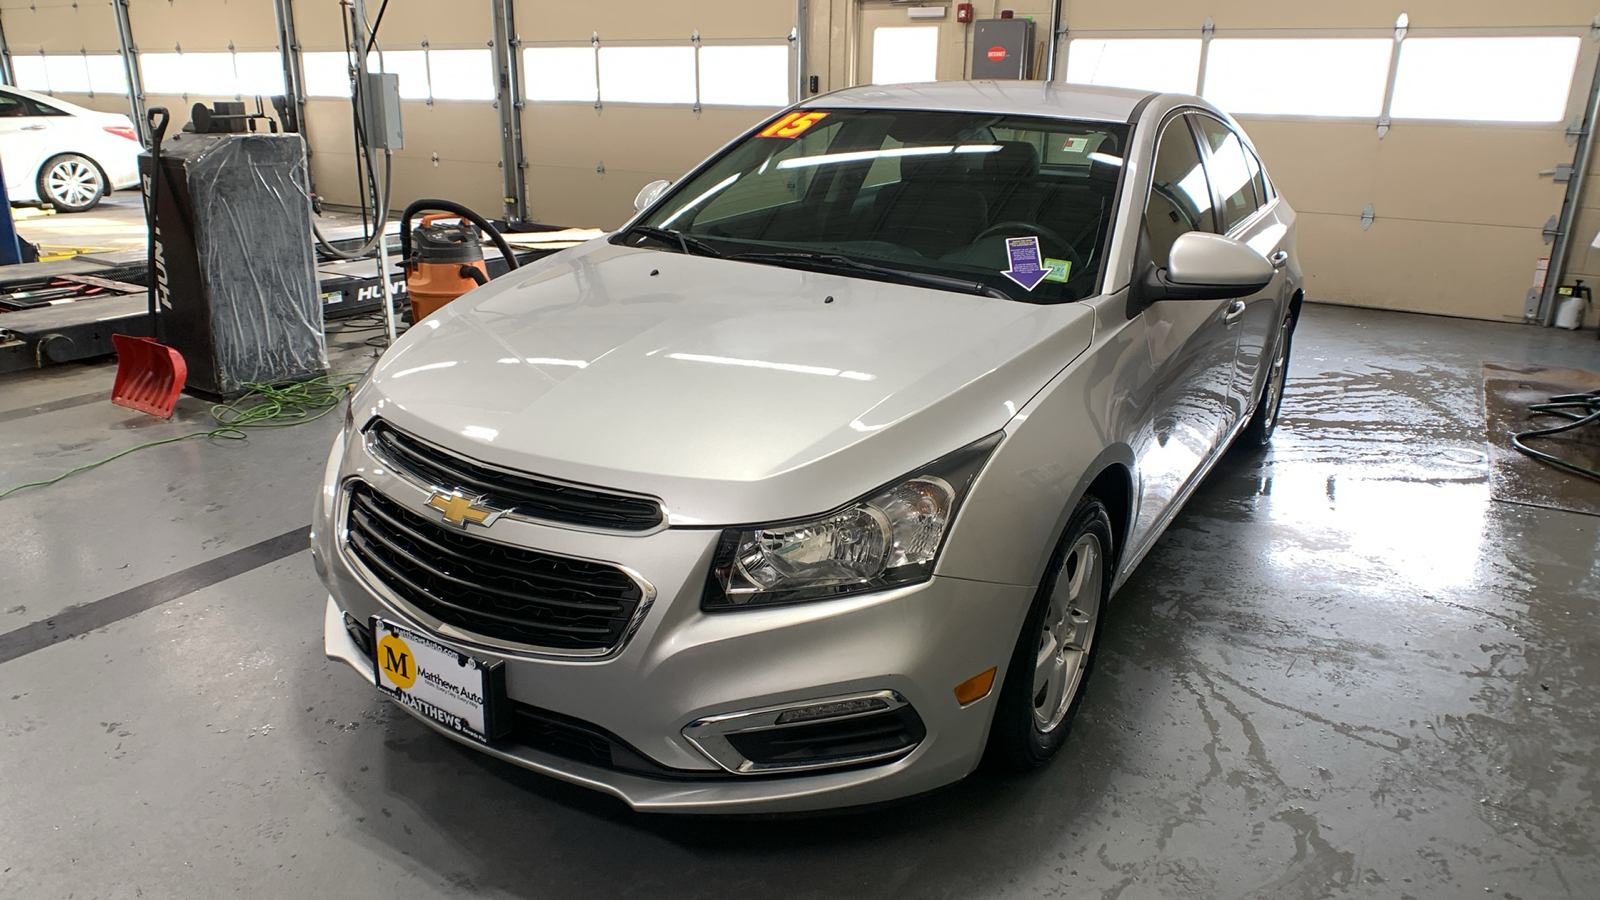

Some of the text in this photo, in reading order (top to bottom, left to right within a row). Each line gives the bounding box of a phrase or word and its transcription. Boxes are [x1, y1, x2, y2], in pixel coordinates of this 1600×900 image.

[760, 112, 827, 137] 15
[384, 645, 410, 680] M
[417, 665, 460, 694] Matthews
[460, 686, 484, 705] Auto
[400, 692, 462, 731] MATTHEWS
